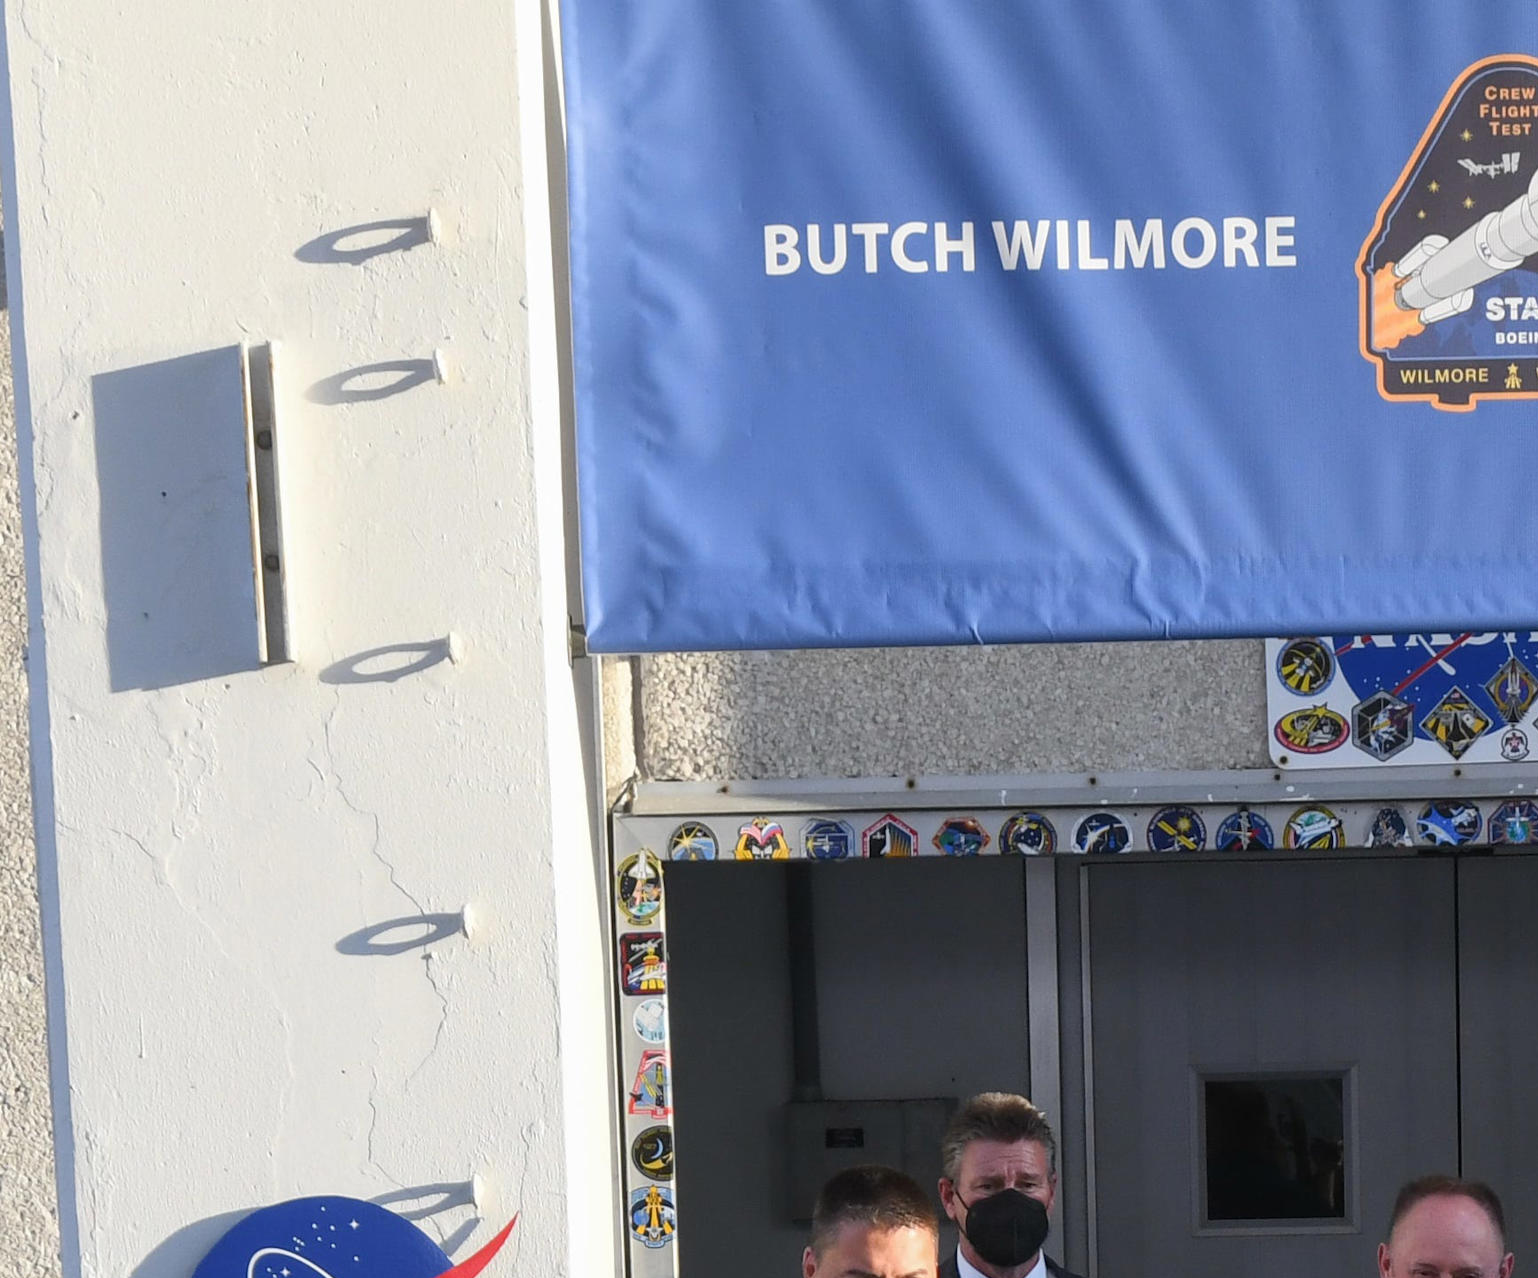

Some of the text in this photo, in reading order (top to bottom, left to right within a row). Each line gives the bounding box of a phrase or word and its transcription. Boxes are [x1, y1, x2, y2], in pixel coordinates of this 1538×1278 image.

[1485, 85, 1536, 100] CREW
[1489, 122, 1532, 136] TEST
[764, 216, 1297, 275] BUTCH WILMORE
[1400, 367, 1488, 384] WILMORE
